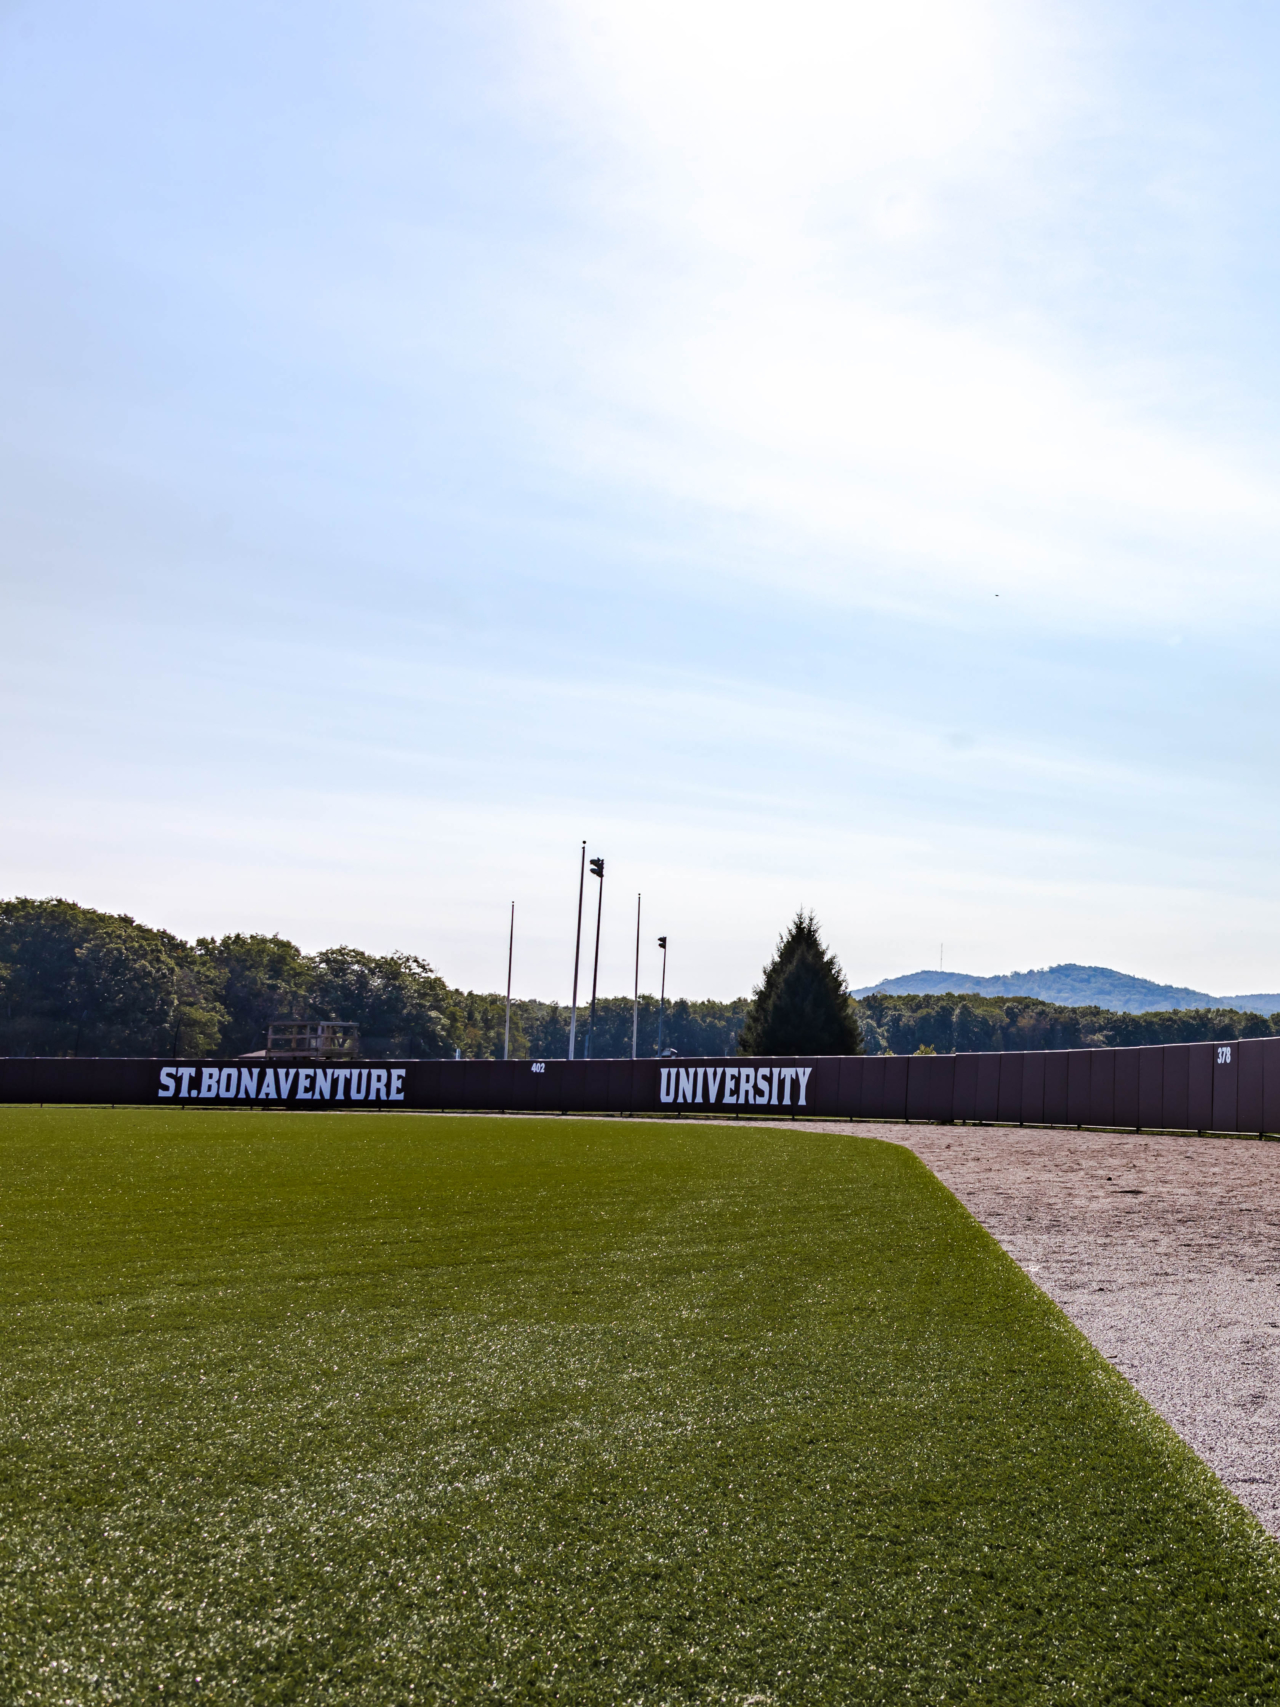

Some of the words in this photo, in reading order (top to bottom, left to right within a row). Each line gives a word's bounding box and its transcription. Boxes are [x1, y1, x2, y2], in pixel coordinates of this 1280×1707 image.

[1217, 1046, 1231, 1064] 378
[531, 1062, 545, 1073] 402
[660, 1067, 812, 1105] UNIVERSITY
